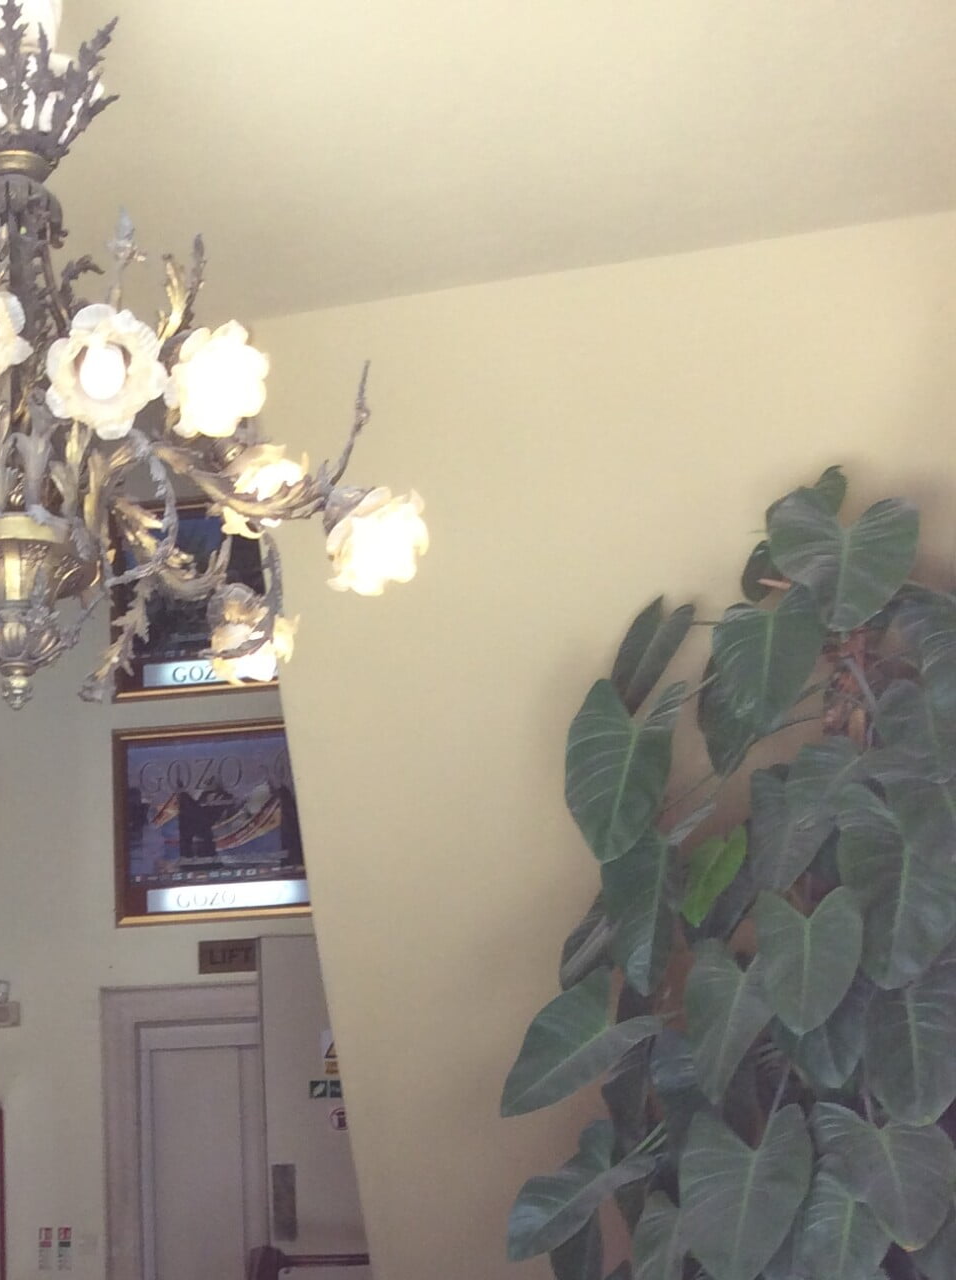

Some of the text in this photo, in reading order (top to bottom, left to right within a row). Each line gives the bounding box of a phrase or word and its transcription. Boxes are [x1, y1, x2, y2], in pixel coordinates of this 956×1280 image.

[172, 665, 218, 683] GOZ
[139, 755, 243, 794] GOZO
[208, 946, 253, 965] LIFT
